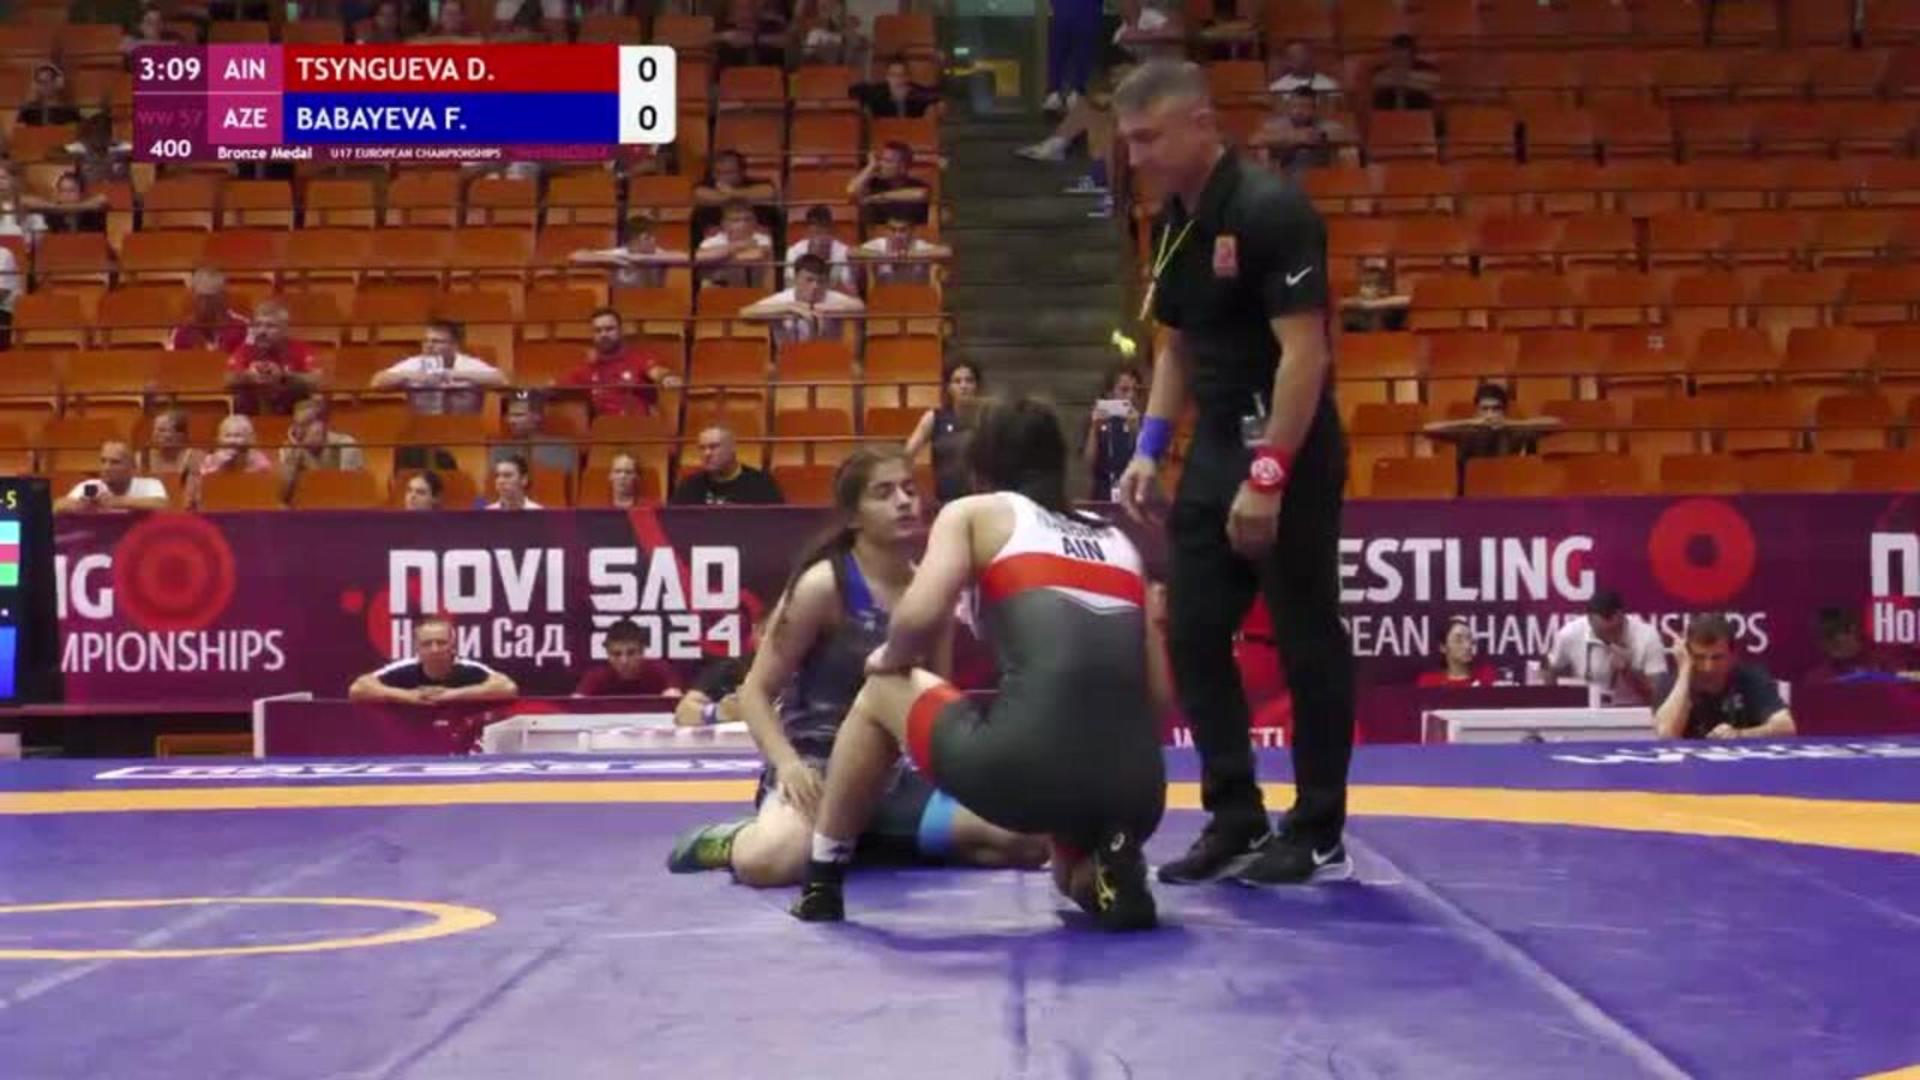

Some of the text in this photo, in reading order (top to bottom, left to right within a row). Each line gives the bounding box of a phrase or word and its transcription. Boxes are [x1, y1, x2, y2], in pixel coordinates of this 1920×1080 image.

[1062, 536, 1105, 561] AIN
[1338, 536, 1595, 603] ESTLING
[389, 545, 740, 614] NOVI SAD
[492, 617, 571, 667] Сад
[1340, 615, 1429, 656] EAN
